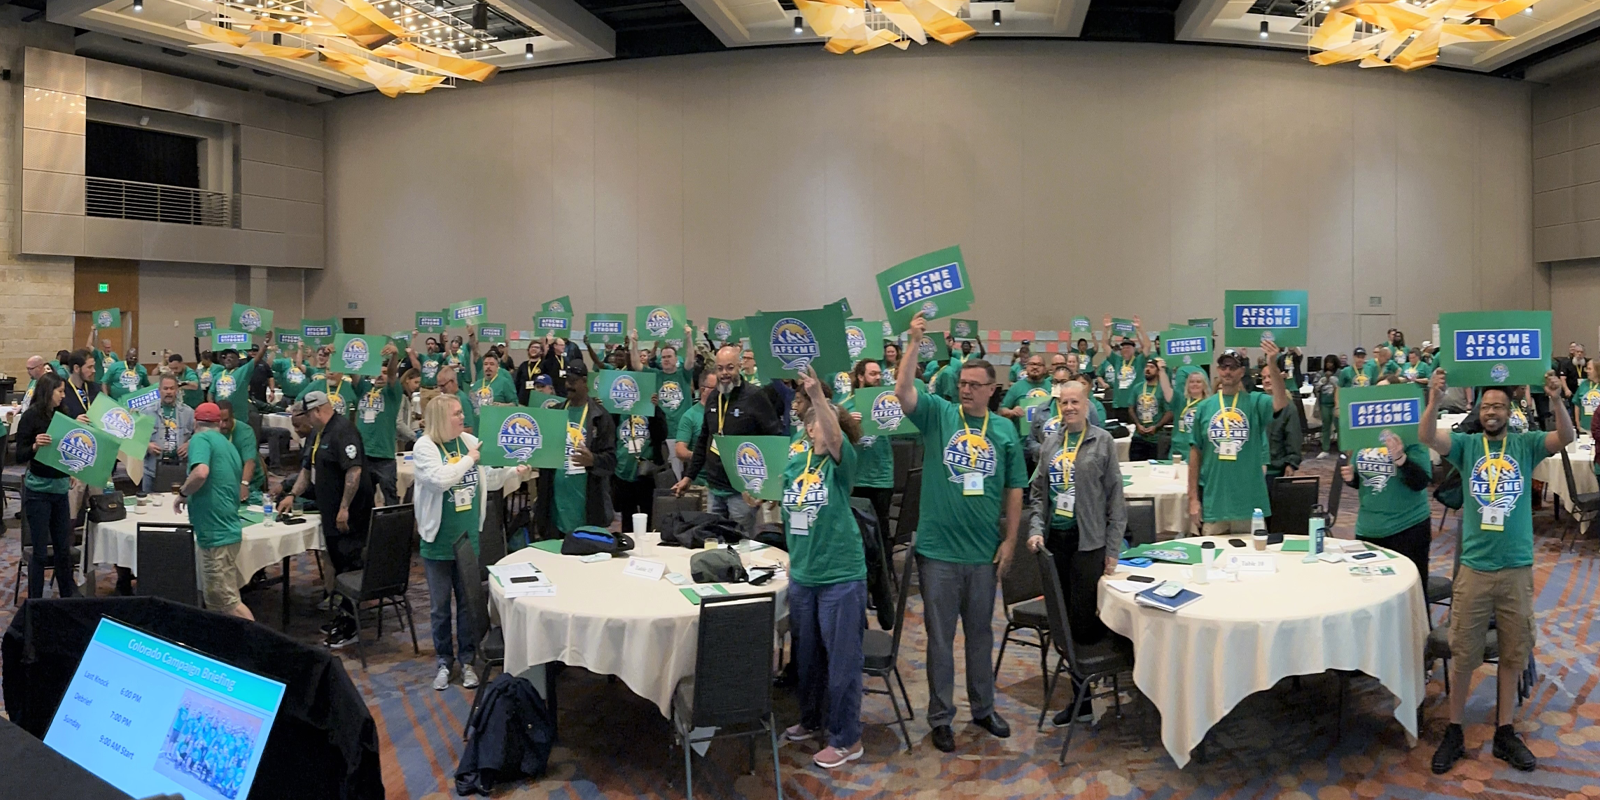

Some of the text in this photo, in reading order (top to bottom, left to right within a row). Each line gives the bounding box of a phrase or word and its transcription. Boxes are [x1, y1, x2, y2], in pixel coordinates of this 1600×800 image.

[897, 269, 951, 295] AFSCME
[898, 280, 953, 305] STRONG
[1242, 308, 1291, 316] AFSCME
[1242, 317, 1291, 325] STRONG
[1171, 339, 1202, 347] AFSCME
[1466, 334, 1531, 345] AFSCME
[774, 345, 816, 354] AFSCME
[1466, 345, 1531, 357] STRONG
[131, 390, 158, 404] AFSCME
[611, 391, 638, 399] AFSCME
[1358, 402, 1412, 415] AFSCME
[1358, 412, 1412, 425] STRONG
[501, 436, 539, 445] AFSCME
[61, 443, 93, 462] AFSCME
[738, 466, 765, 476] AFSCME
[1473, 482, 1521, 493] AFCME
[128, 639, 237, 692] Colorado Campaign Briefing
[84, 670, 109, 688] Last Knock
[74, 692, 93, 707] Debrief
[120, 687, 142, 703] 6:00 PM
[63, 714, 81, 731] Sunday
[110, 710, 132, 727] 7:00 PM
[99, 734, 135, 760] 9:00 AM Start
